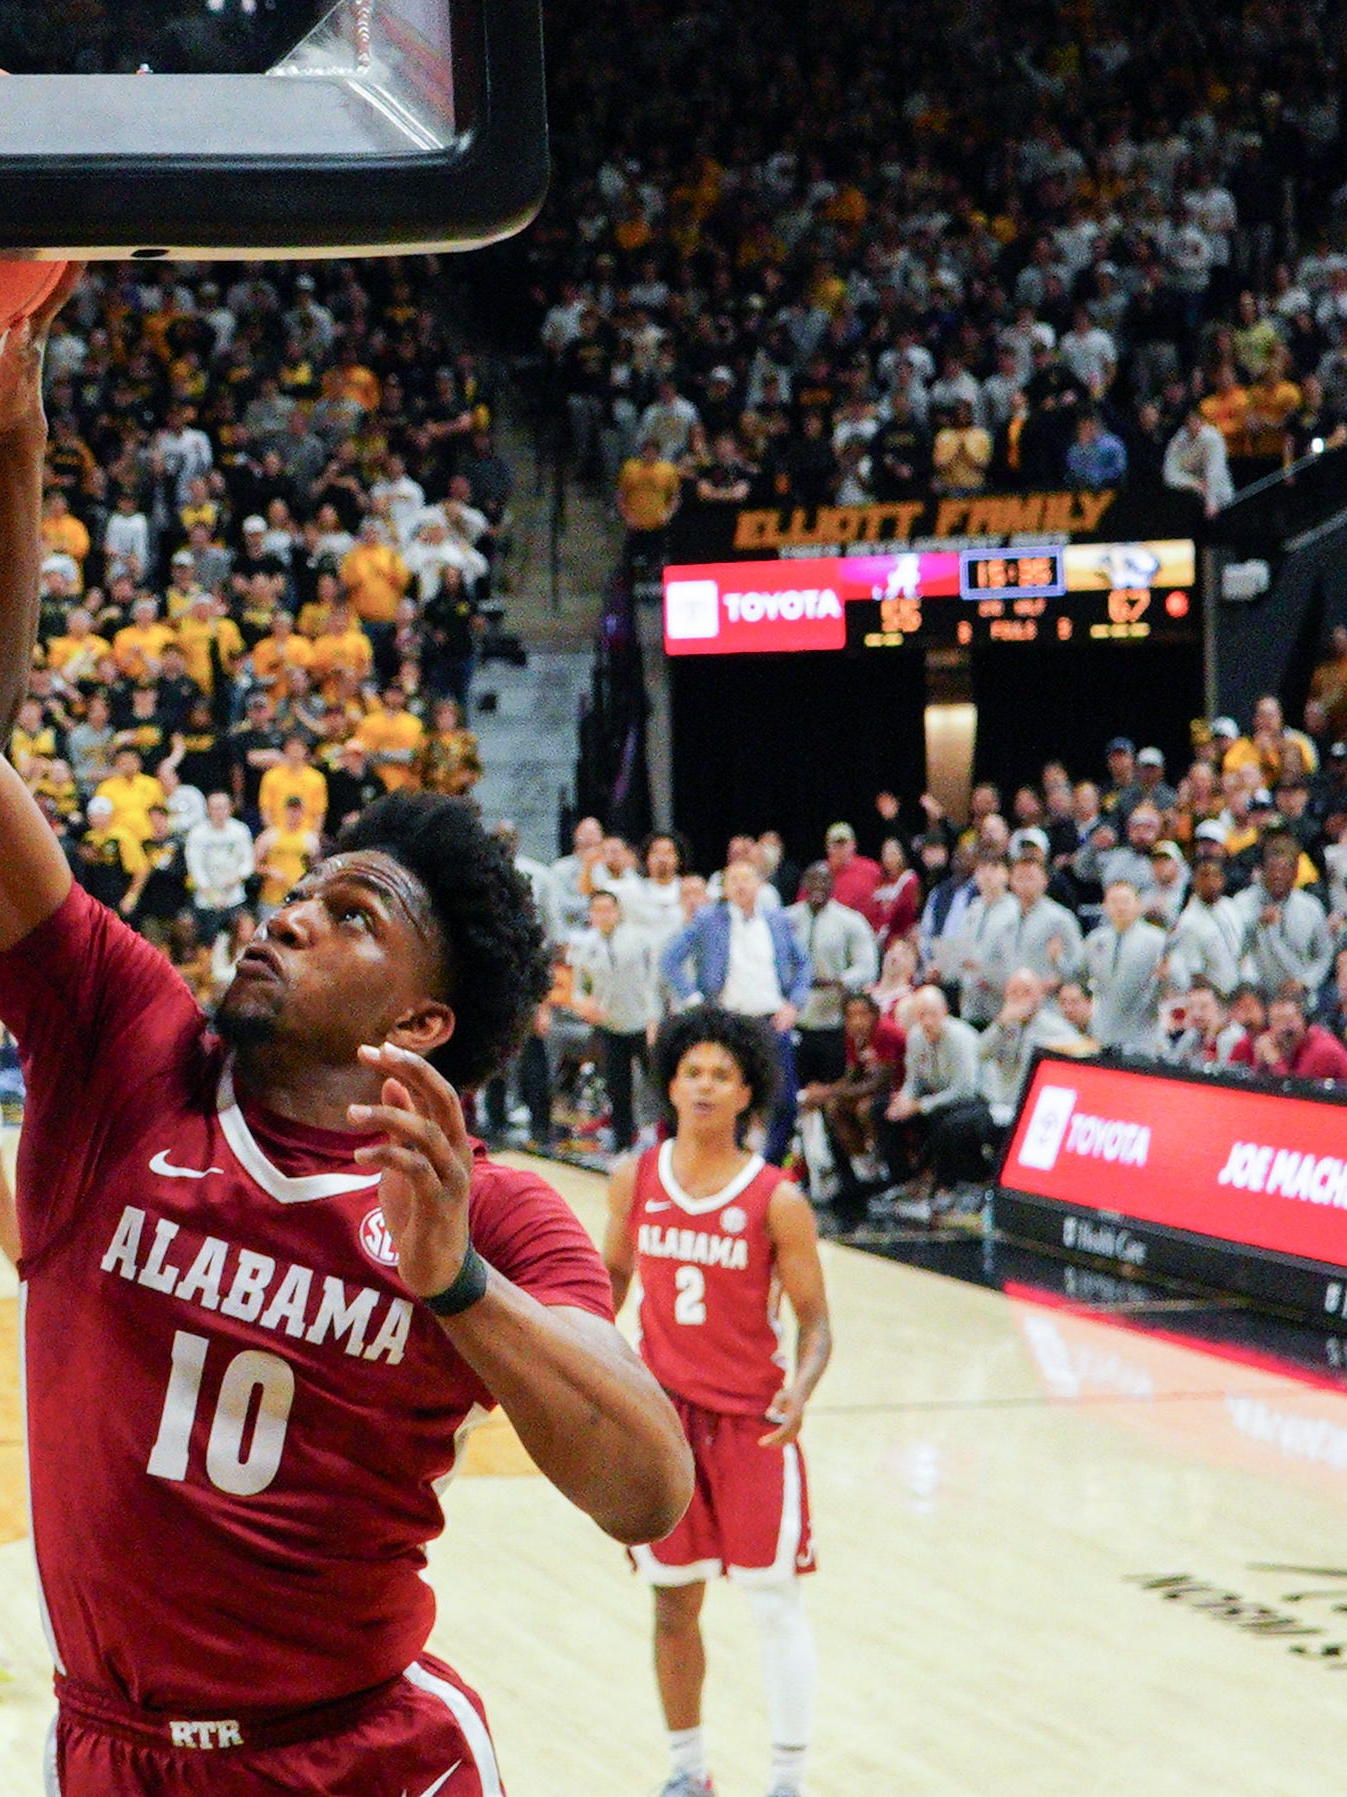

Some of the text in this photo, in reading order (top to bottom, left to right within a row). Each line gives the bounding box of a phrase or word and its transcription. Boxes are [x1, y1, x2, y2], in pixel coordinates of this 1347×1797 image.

[723, 589, 842, 622] TOYOTA
[1066, 1113, 1151, 1167] TOYOTA
[1218, 1141, 1273, 1193] JOE
[638, 1223, 749, 1271] ALABAMA
[100, 1205, 414, 1365] ALABAMA
[674, 1264, 707, 1326] 2
[146, 1330, 295, 1497] 10
[168, 1719, 244, 1750] RTR
